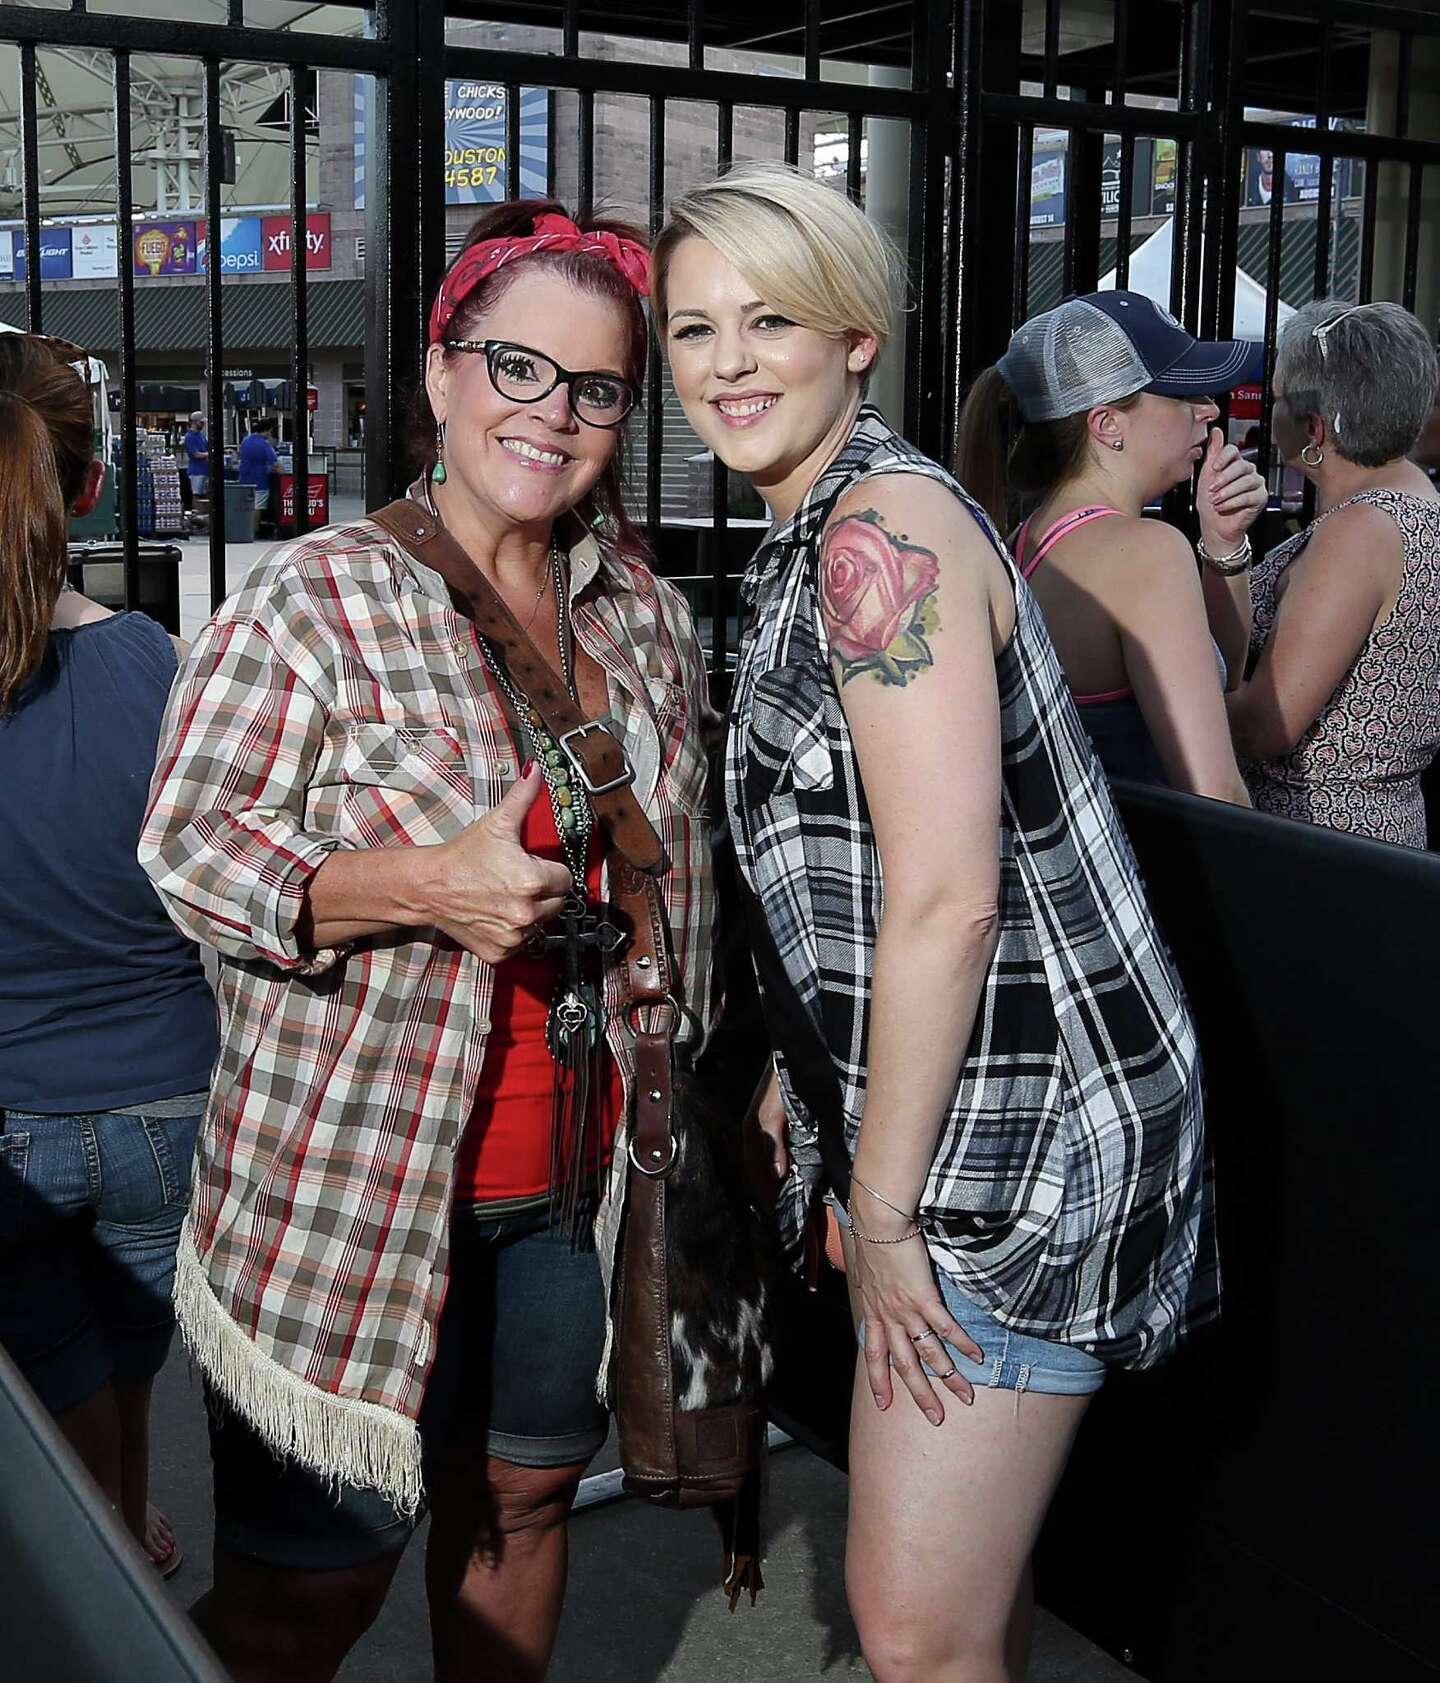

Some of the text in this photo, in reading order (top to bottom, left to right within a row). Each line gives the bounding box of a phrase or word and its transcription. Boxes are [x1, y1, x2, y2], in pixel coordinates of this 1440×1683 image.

[457, 85, 506, 99] CHICKS
[445, 105, 502, 120] YWOOD!
[445, 147, 506, 165] OUSTON
[268, 230, 325, 256] xfity
[41, 247, 69, 257] LIGHT
